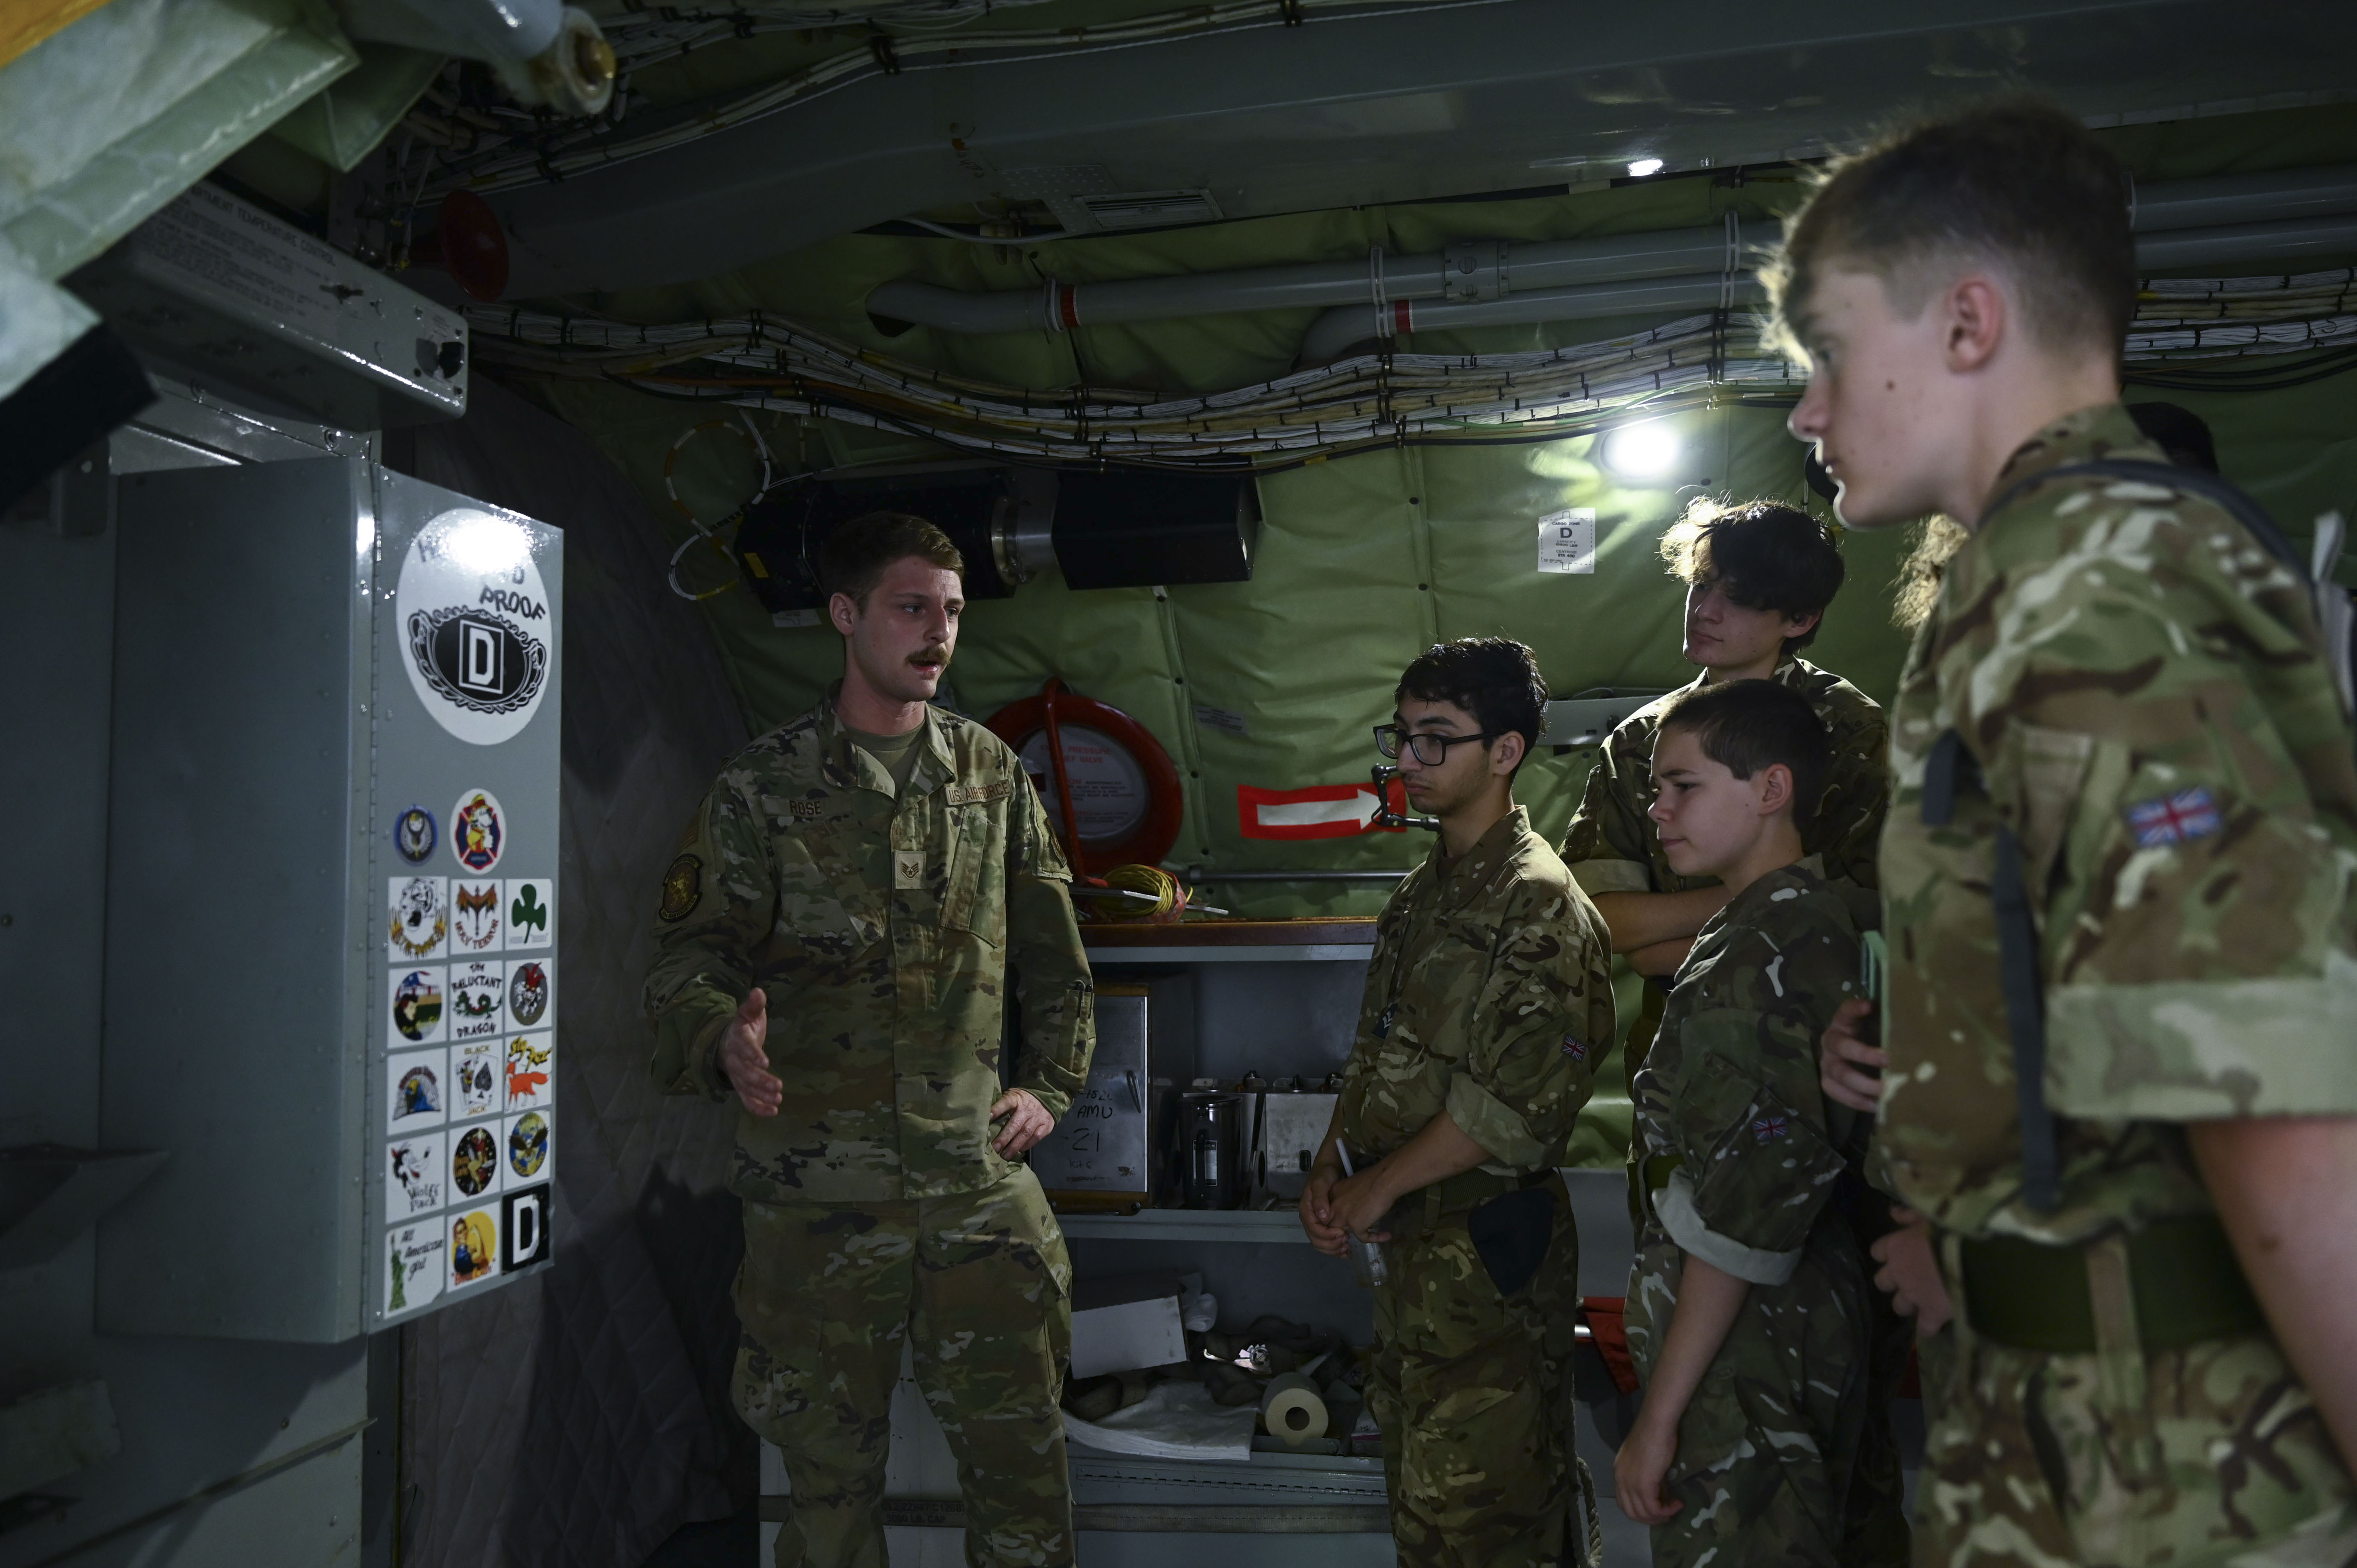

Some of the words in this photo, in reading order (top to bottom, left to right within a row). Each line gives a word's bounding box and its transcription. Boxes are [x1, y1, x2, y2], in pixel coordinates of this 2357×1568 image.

[237, 208, 297, 247] TEMPERATURE
[1560, 527, 1572, 538] D
[480, 585, 546, 620] PROOF
[468, 627, 495, 686] D
[1068, 746, 1110, 754] PRESSURE
[789, 800, 821, 815] ROSE
[457, 1023, 497, 1038] DRAGON
[464, 1045, 490, 1055] BLACK
[1077, 1105, 1113, 1119] AMU
[513, 1194, 540, 1265] D
